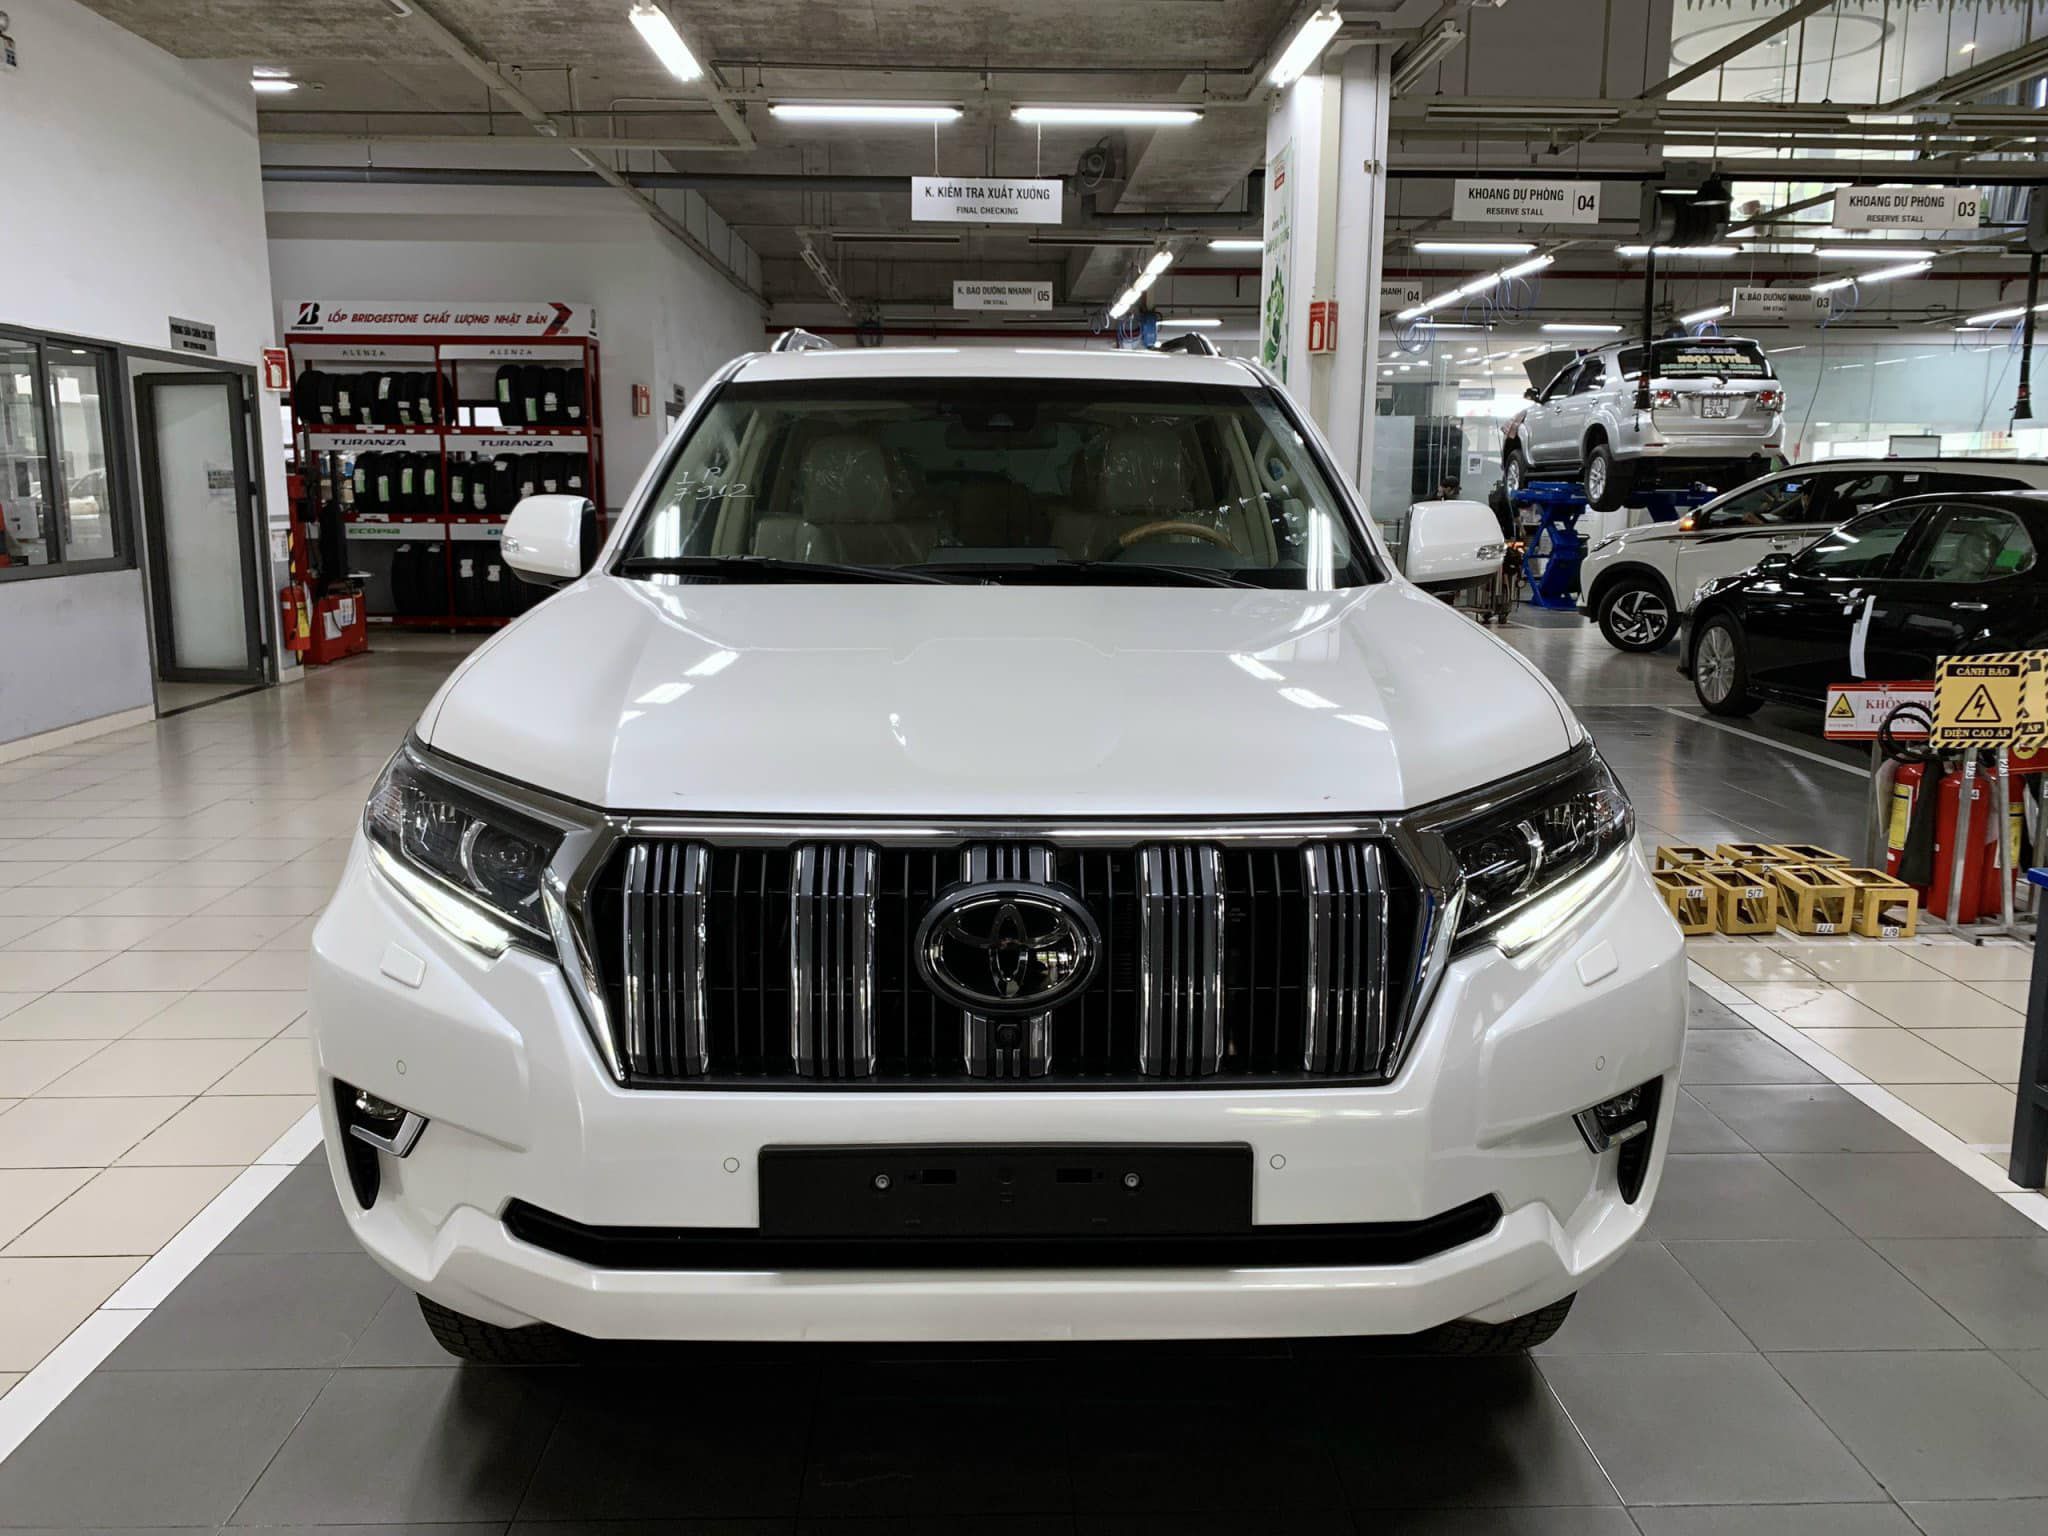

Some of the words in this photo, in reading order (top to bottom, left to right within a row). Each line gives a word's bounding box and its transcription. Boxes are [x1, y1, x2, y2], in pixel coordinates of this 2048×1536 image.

[924, 186, 935, 198] K.
[966, 186, 985, 199] TRA
[1468, 187, 1510, 200] KHOANG
[1577, 195, 1595, 211] 04
[1849, 195, 1891, 208] KHOANG
[956, 206, 978, 215] FINAL
[980, 206, 1019, 216] CHECKING
[1486, 207, 1519, 216] RESERVE
[1521, 207, 1544, 216] STALL
[1957, 201, 1976, 217] 03
[1866, 214, 1899, 223] RESERVE
[1901, 214, 1924, 223] STALL
[1007, 286, 1033, 296] NHANH
[1037, 290, 1050, 302] 05
[1407, 290, 1420, 302] 04
[1816, 297, 1830, 308] 03
[327, 308, 348, 323] LỐP
[351, 312, 419, 324] BRIDGESTONE
[341, 348, 387, 358] ALENZA
[489, 348, 533, 356] ALENZA
[330, 437, 407, 447] TURANZA
[479, 439, 554, 448] TURANZA
[1988, 665, 2010, 676] BÁO
[1972, 729, 1994, 738] CAO
[1996, 727, 2011, 737] ÁP
[1687, 888, 1703, 898] 4/7
[1747, 888, 1762, 898] 5/7
